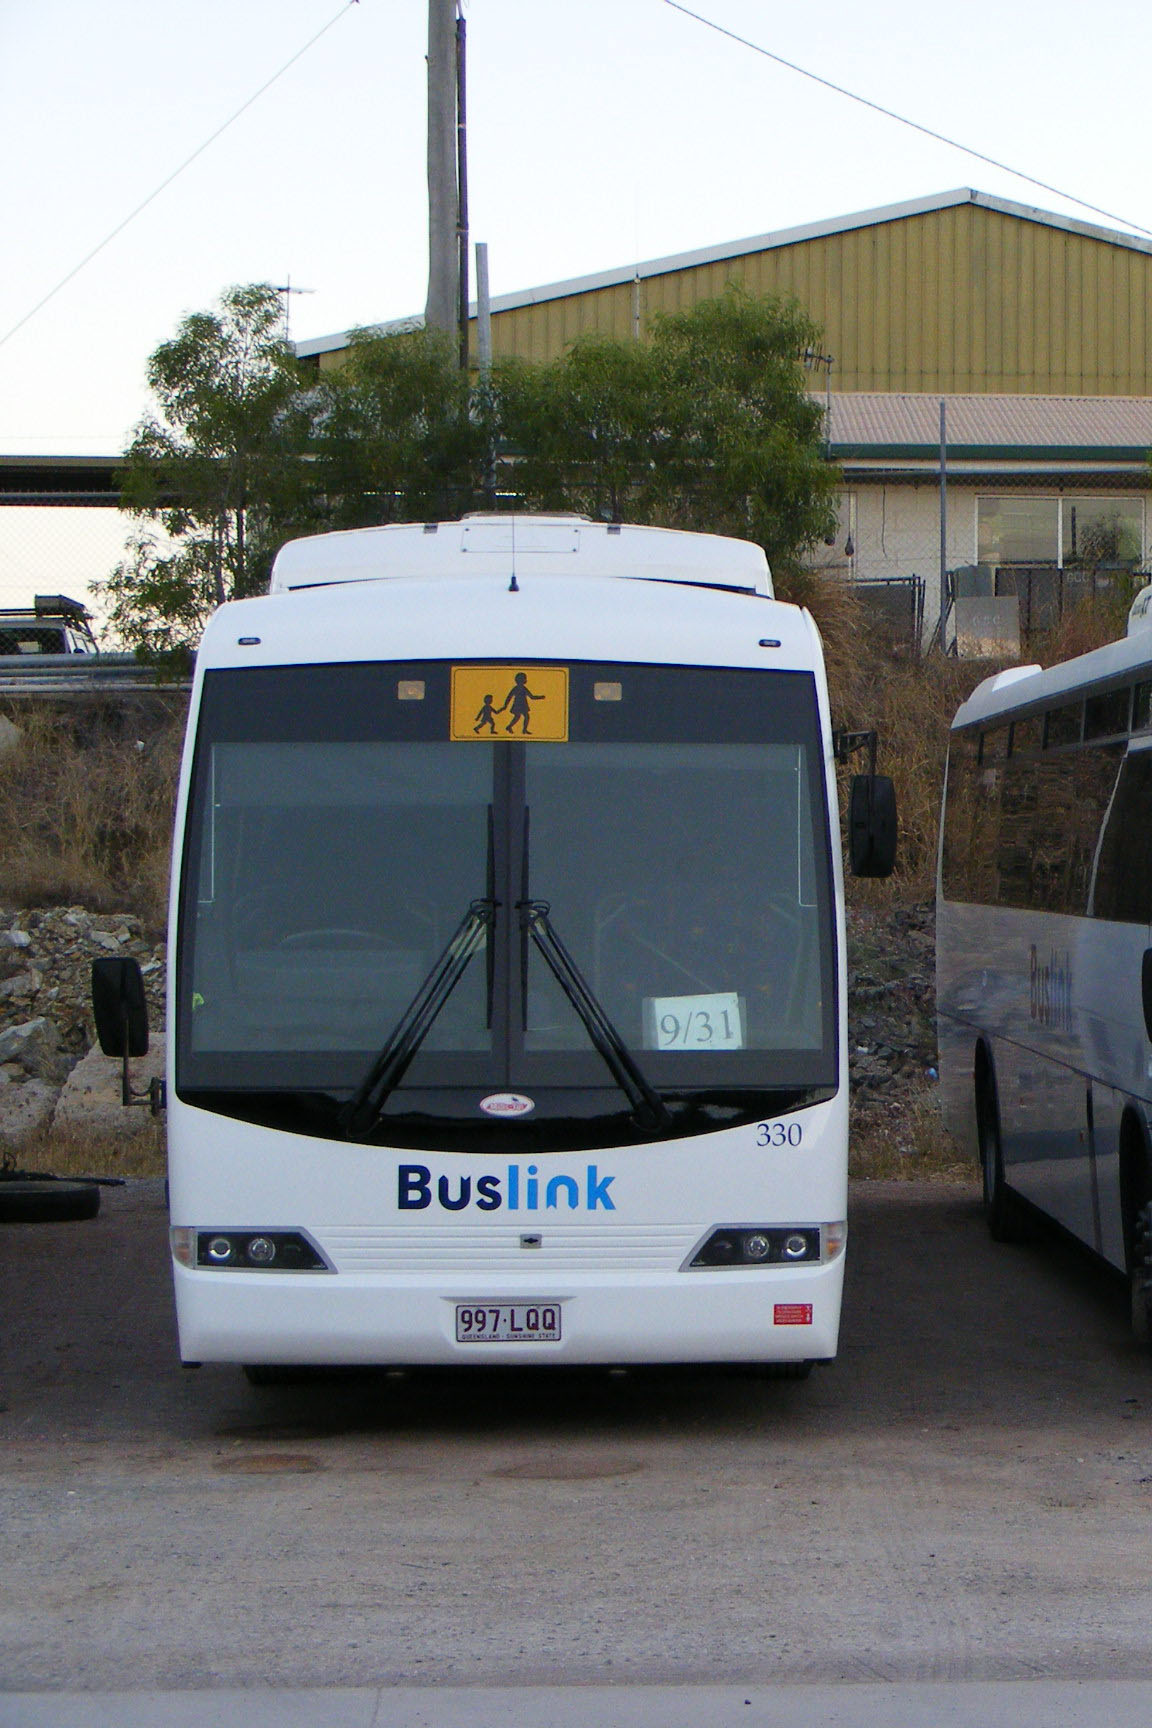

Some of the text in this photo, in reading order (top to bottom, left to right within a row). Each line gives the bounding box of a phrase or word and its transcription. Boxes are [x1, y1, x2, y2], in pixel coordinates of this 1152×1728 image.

[661, 1010, 733, 1045] 9/31
[756, 1123, 802, 1147] 330
[398, 1165, 617, 1211] Buslink
